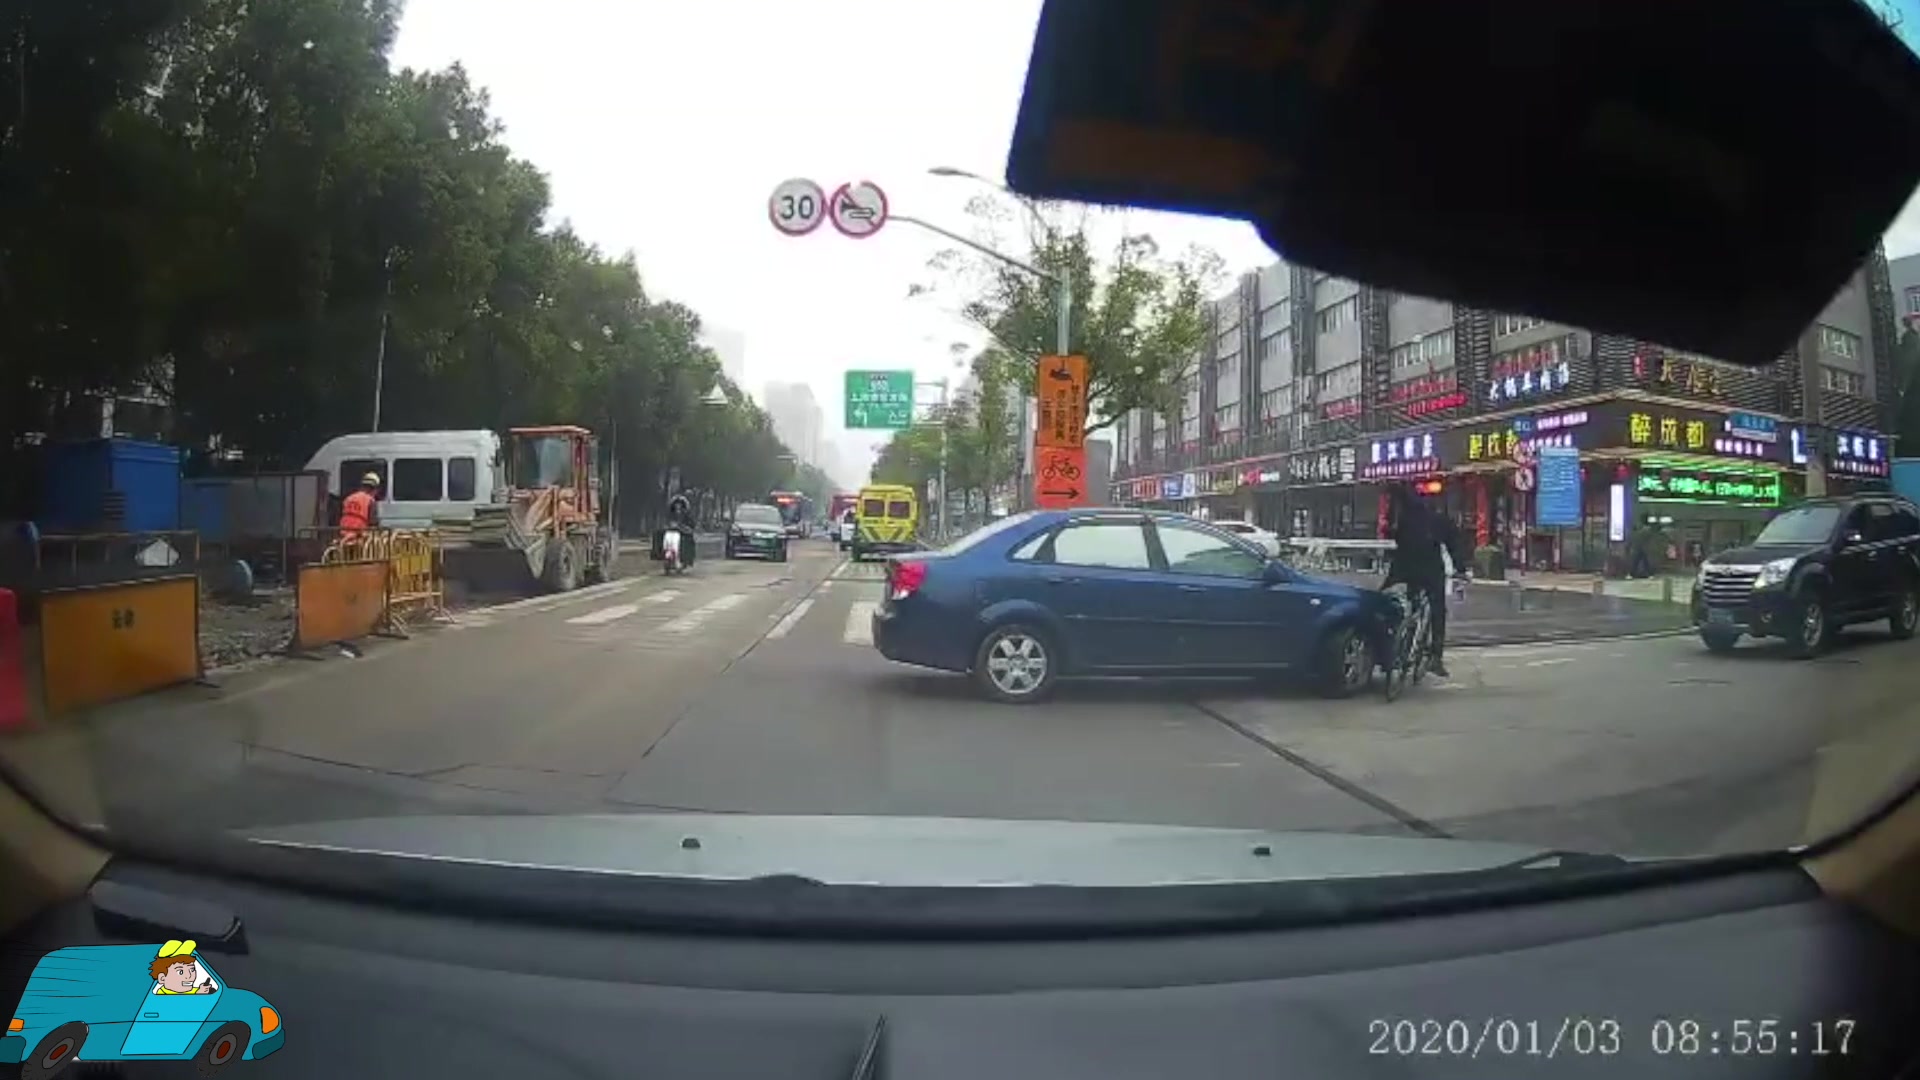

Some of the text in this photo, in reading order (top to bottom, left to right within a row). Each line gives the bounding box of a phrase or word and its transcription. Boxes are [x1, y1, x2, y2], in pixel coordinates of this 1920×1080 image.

[781, 195, 815, 220] 30
[1630, 413, 1705, 449] 醉成都
